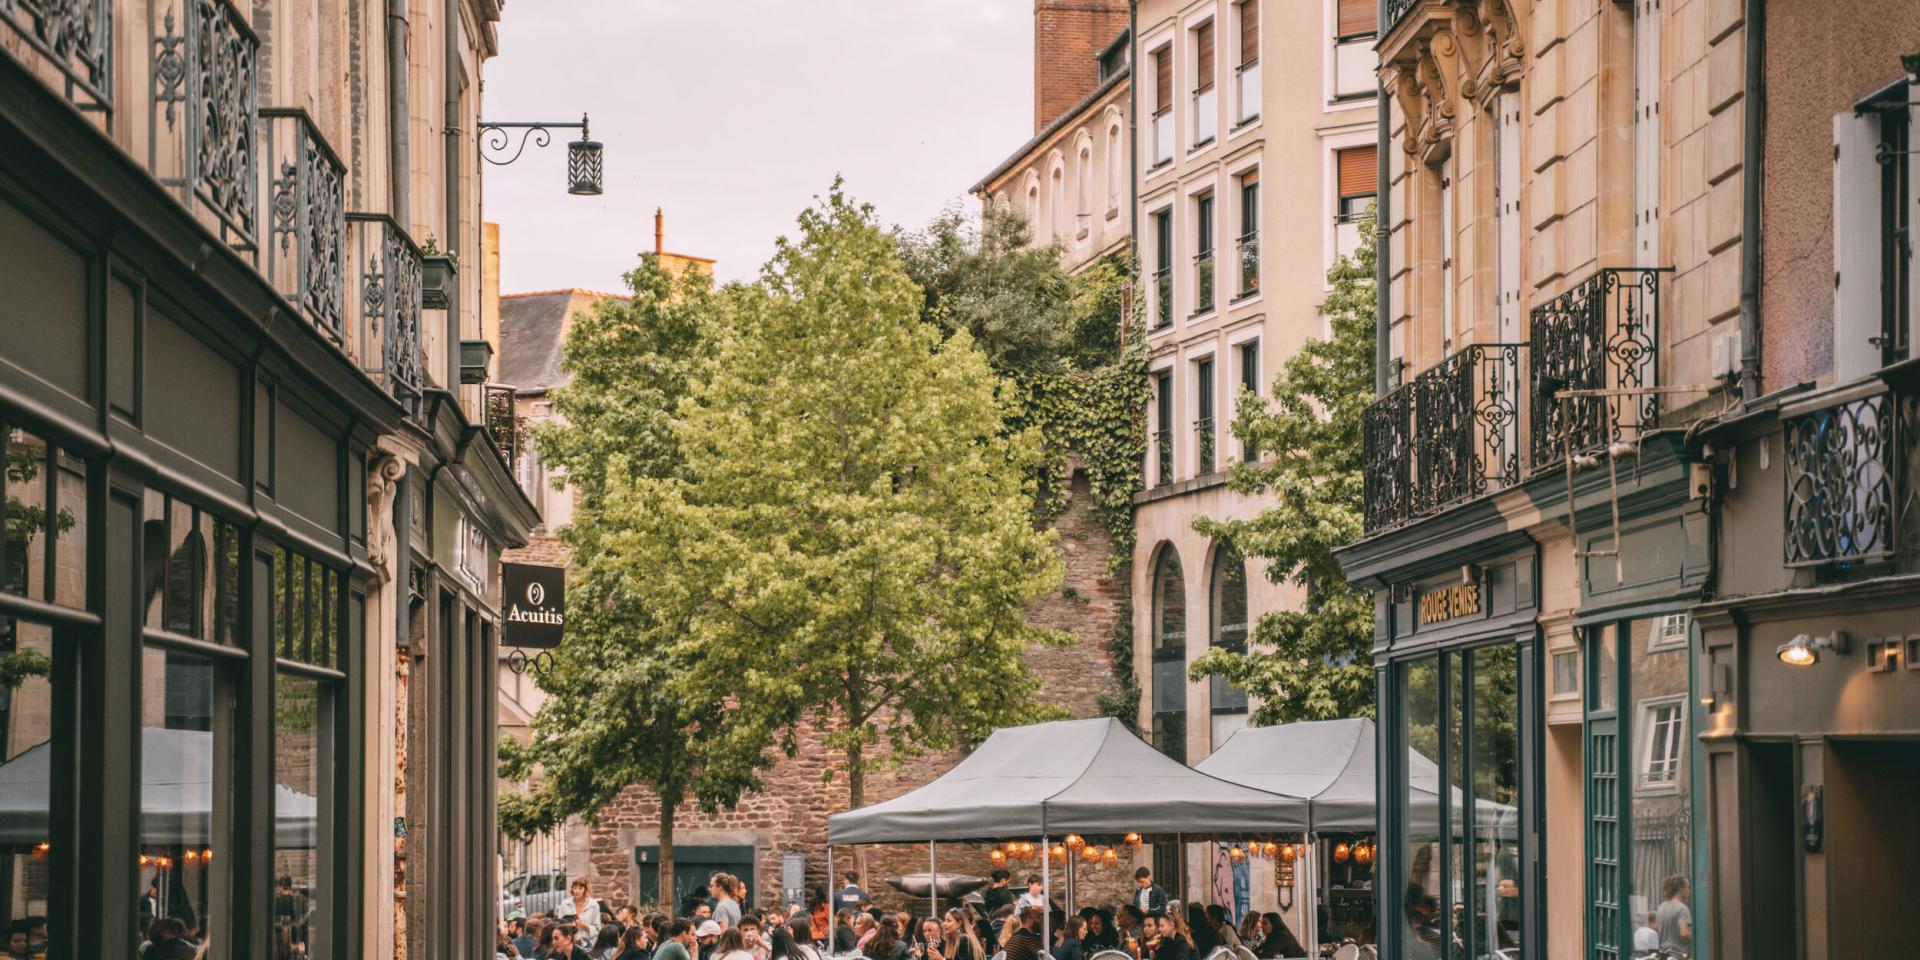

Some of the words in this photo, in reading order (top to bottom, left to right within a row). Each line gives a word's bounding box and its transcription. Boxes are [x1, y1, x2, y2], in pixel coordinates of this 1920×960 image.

[508, 603, 563, 625] Acuitis
[1421, 589, 1449, 625] ROUGE
[1449, 585, 1478, 618] VENISE
